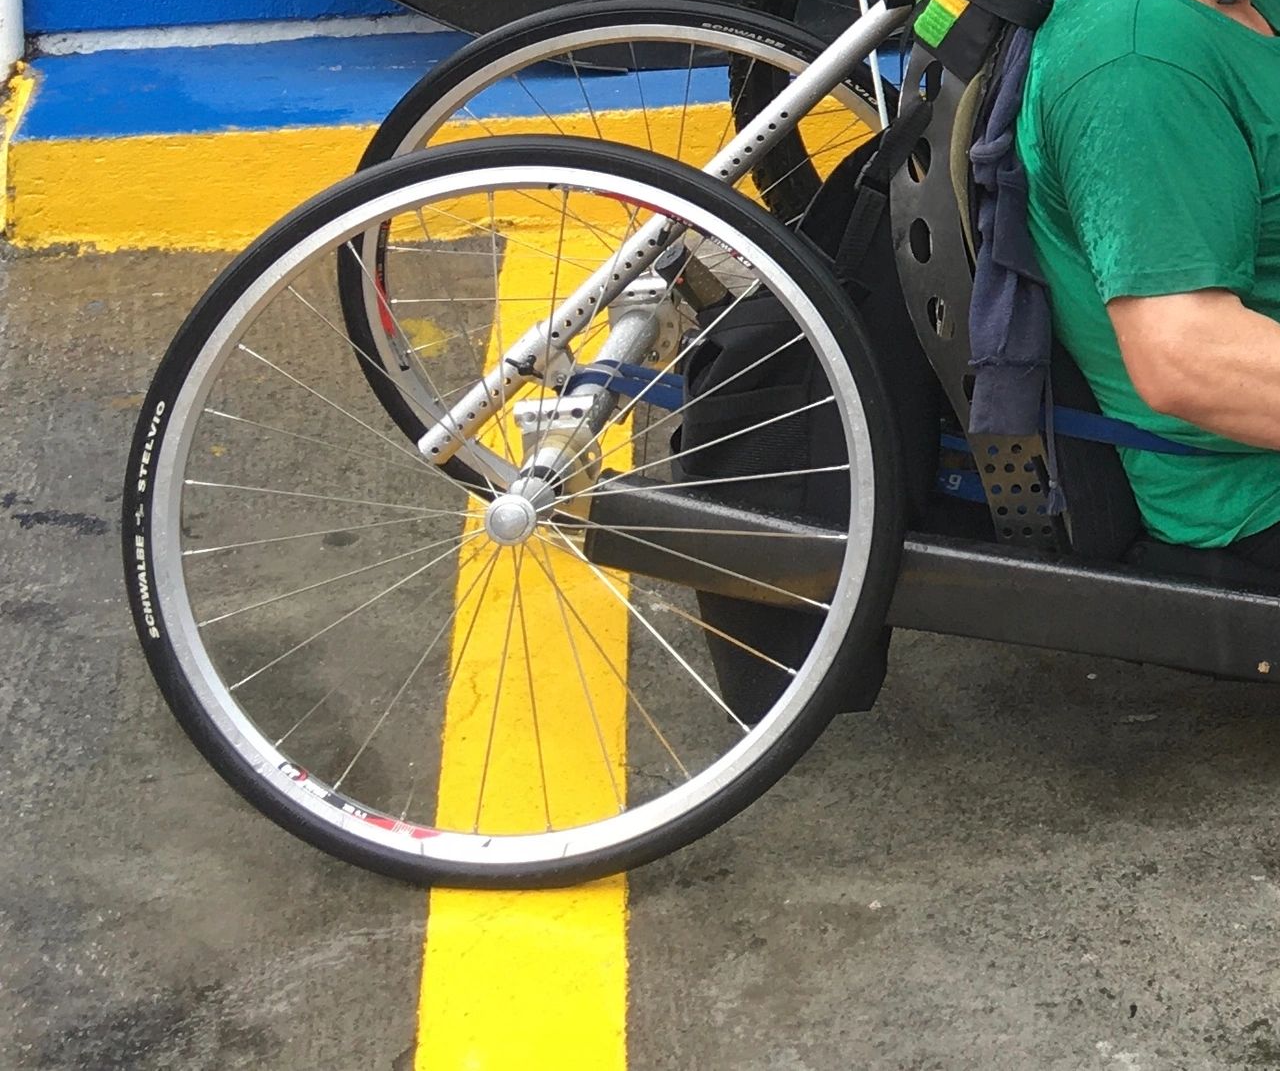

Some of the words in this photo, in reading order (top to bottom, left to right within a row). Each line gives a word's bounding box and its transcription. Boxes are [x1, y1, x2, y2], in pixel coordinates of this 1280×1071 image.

[701, 22, 786, 49] SCHWALBE
[138, 400, 166, 492] STELVIO
[135, 535, 161, 638] SCHWALBE
